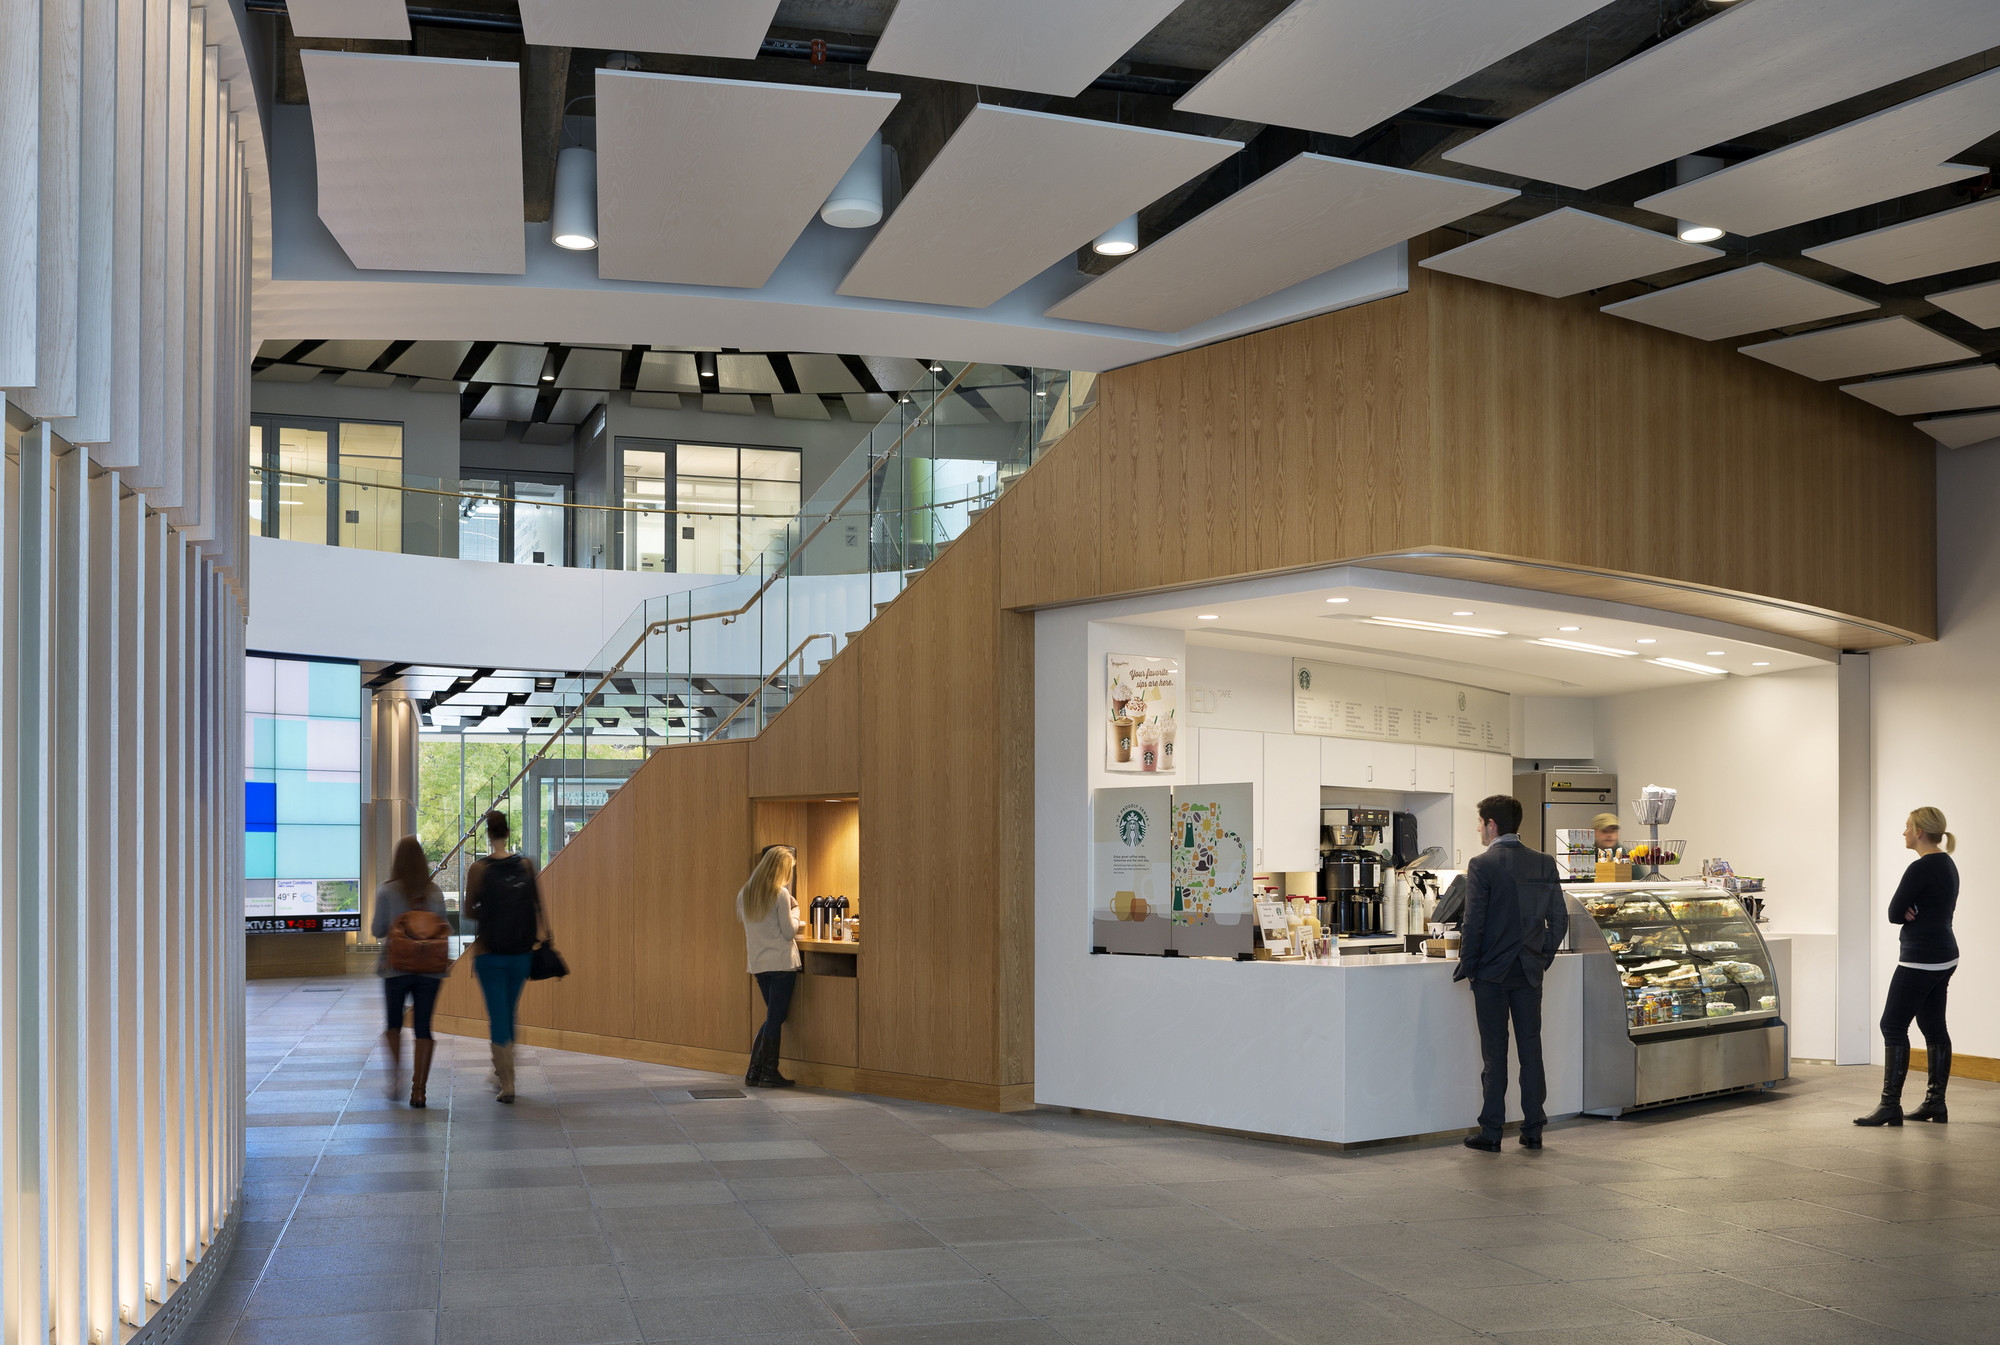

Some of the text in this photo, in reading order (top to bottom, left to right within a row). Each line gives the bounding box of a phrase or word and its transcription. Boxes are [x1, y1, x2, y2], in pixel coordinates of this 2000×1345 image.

[1129, 668, 1169, 680] Your favorite
[1136, 679, 1174, 689] sips are here.
[1120, 804, 1138, 813] PROUDLY
[1139, 807, 1149, 821] SERVE
[266, 920, 285, 928] 5.13
[323, 919, 341, 927] HPJ
